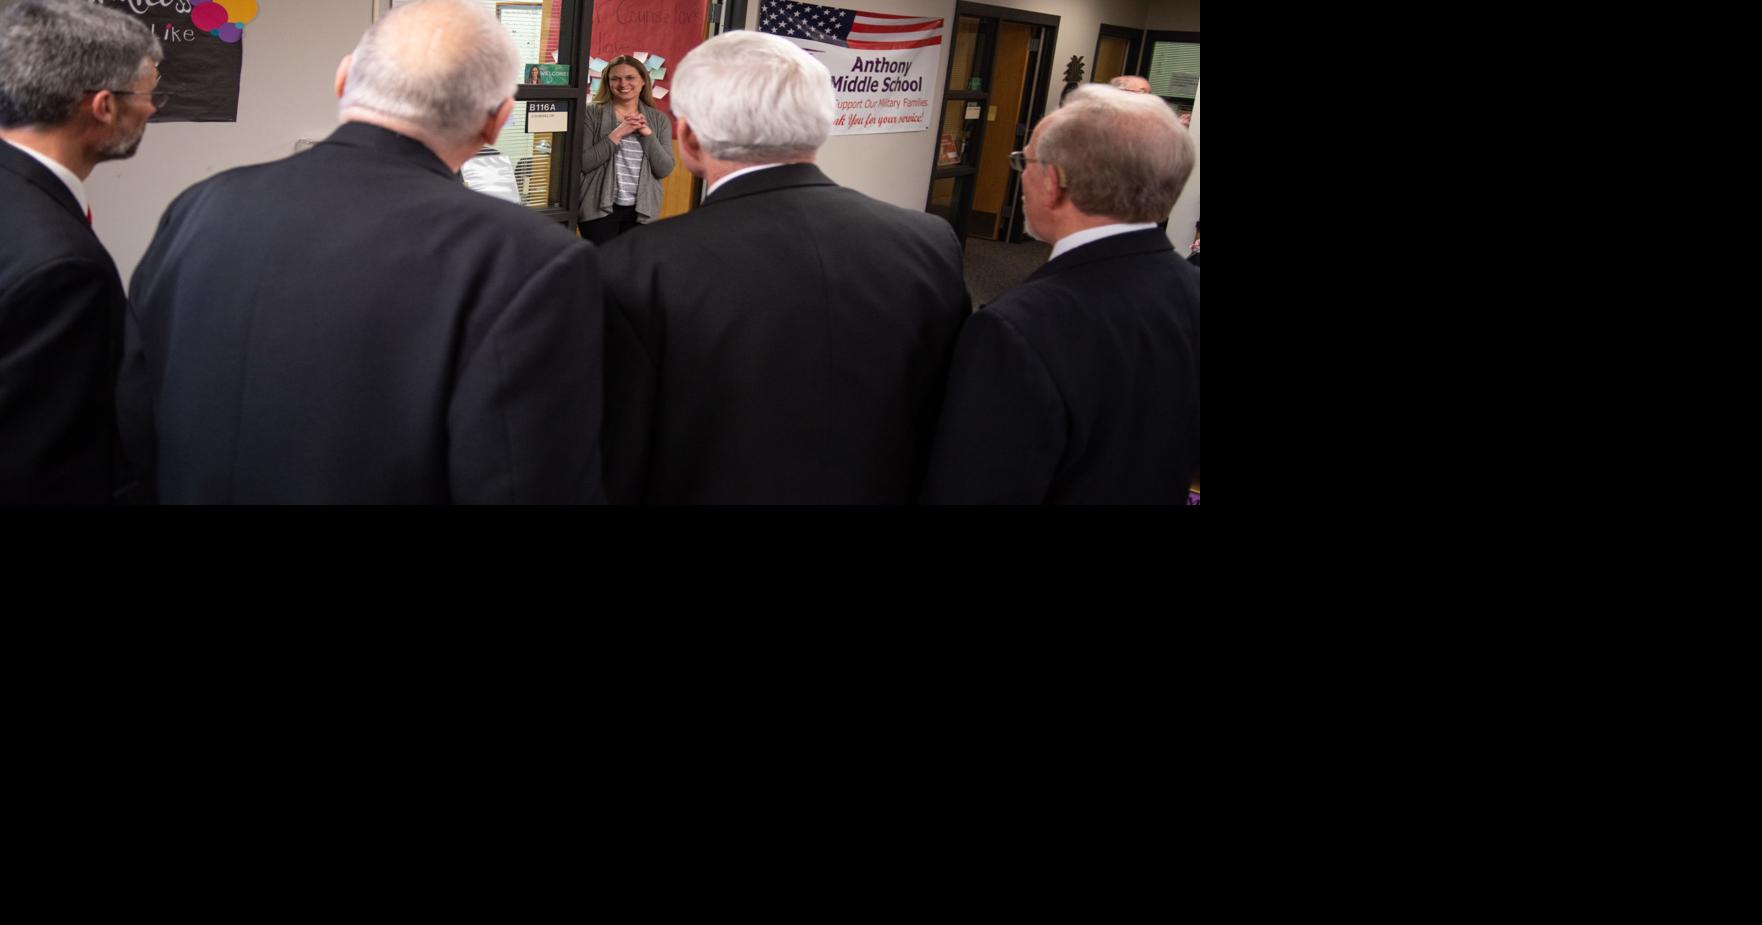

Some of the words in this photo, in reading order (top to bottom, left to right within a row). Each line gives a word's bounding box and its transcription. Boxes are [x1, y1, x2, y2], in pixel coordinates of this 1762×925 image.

[851, 56, 912, 77] Anthony
[831, 75, 879, 93] Middle
[881, 76, 923, 93] School
[529, 103, 556, 111] B116A
[834, 98, 862, 110] upport
[864, 99, 878, 109] Our
[879, 98, 900, 109] Military
[848, 113, 864, 129] You
[864, 112, 876, 128] for
[877, 115, 897, 128] your
